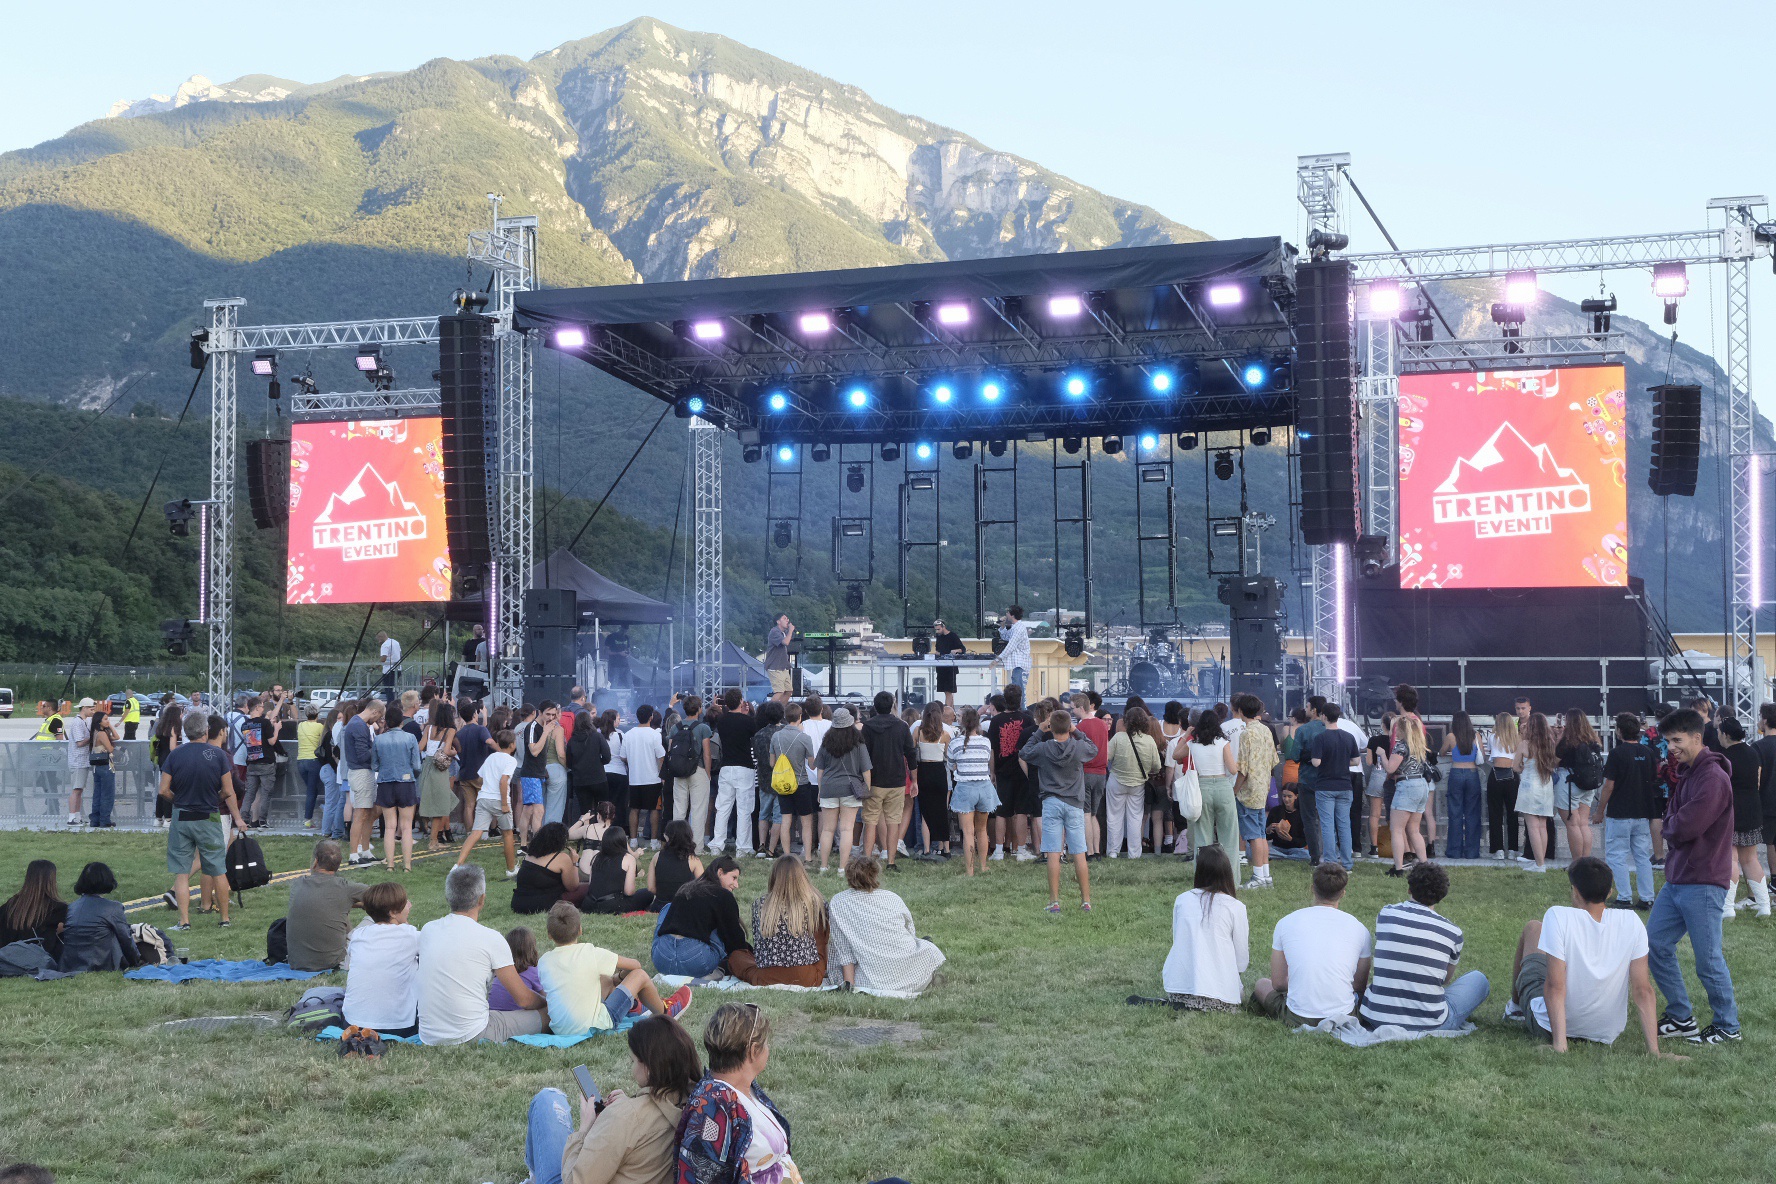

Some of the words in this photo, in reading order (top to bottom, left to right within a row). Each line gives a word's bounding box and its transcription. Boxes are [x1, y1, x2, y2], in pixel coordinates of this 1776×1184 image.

[1435, 489, 1588, 519] TRENTINO
[314, 519, 425, 545] TRENTINO
[1477, 516, 1550, 535] EVENTI
[344, 543, 396, 559] EVENTI
